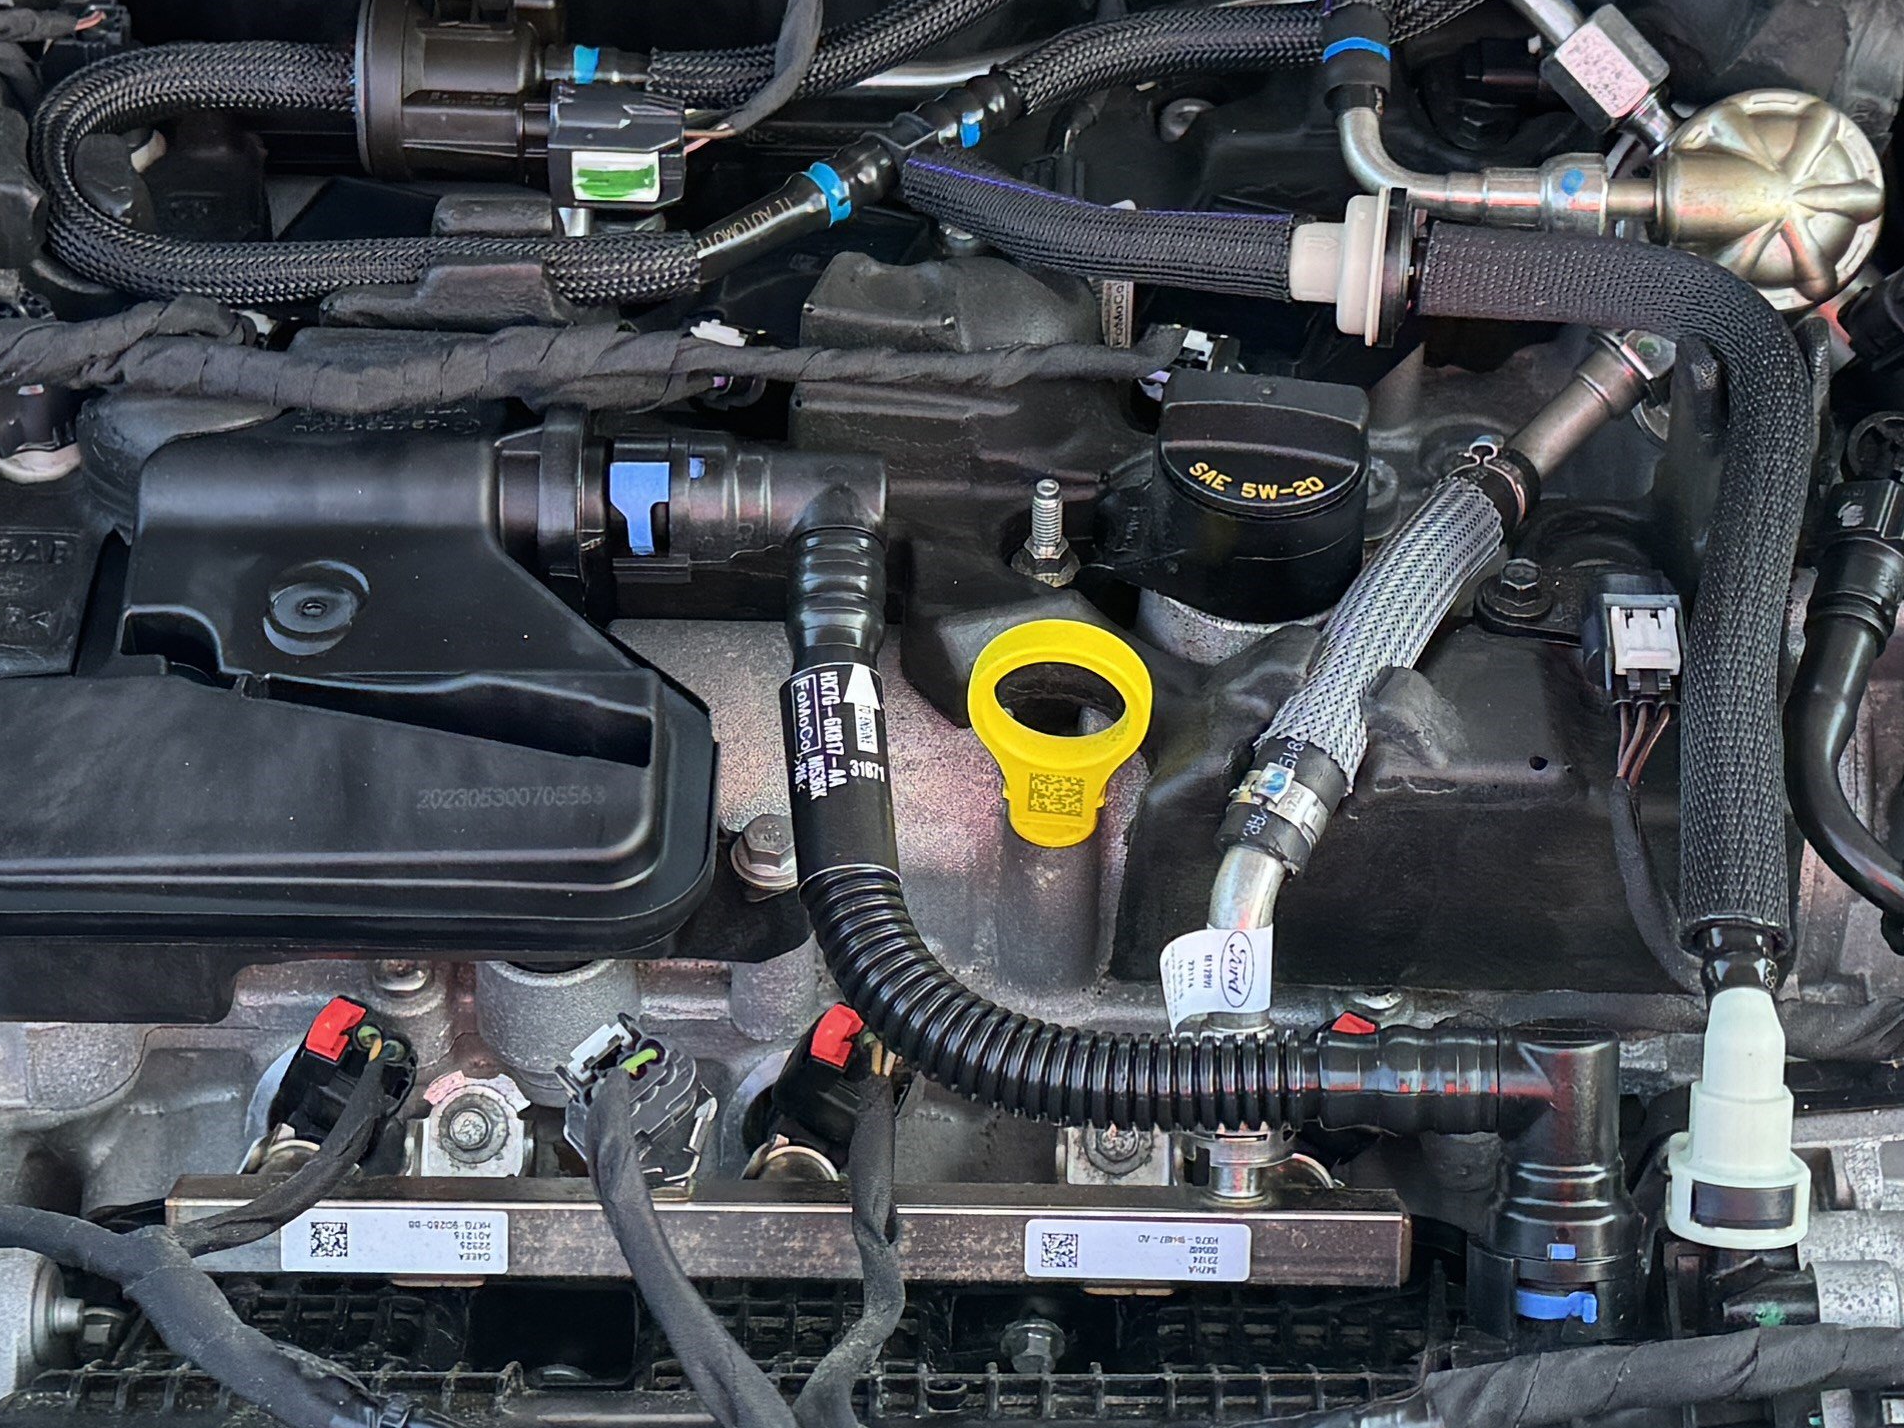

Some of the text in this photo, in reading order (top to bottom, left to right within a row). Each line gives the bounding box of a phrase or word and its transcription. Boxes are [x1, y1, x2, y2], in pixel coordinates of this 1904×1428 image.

[1189, 461, 1325, 501] SAE 5W-20
[795, 678, 813, 750] FoMoCo
[820, 671, 847, 787] HX7G-6K817-AA
[1228, 944, 1247, 995] Ford
